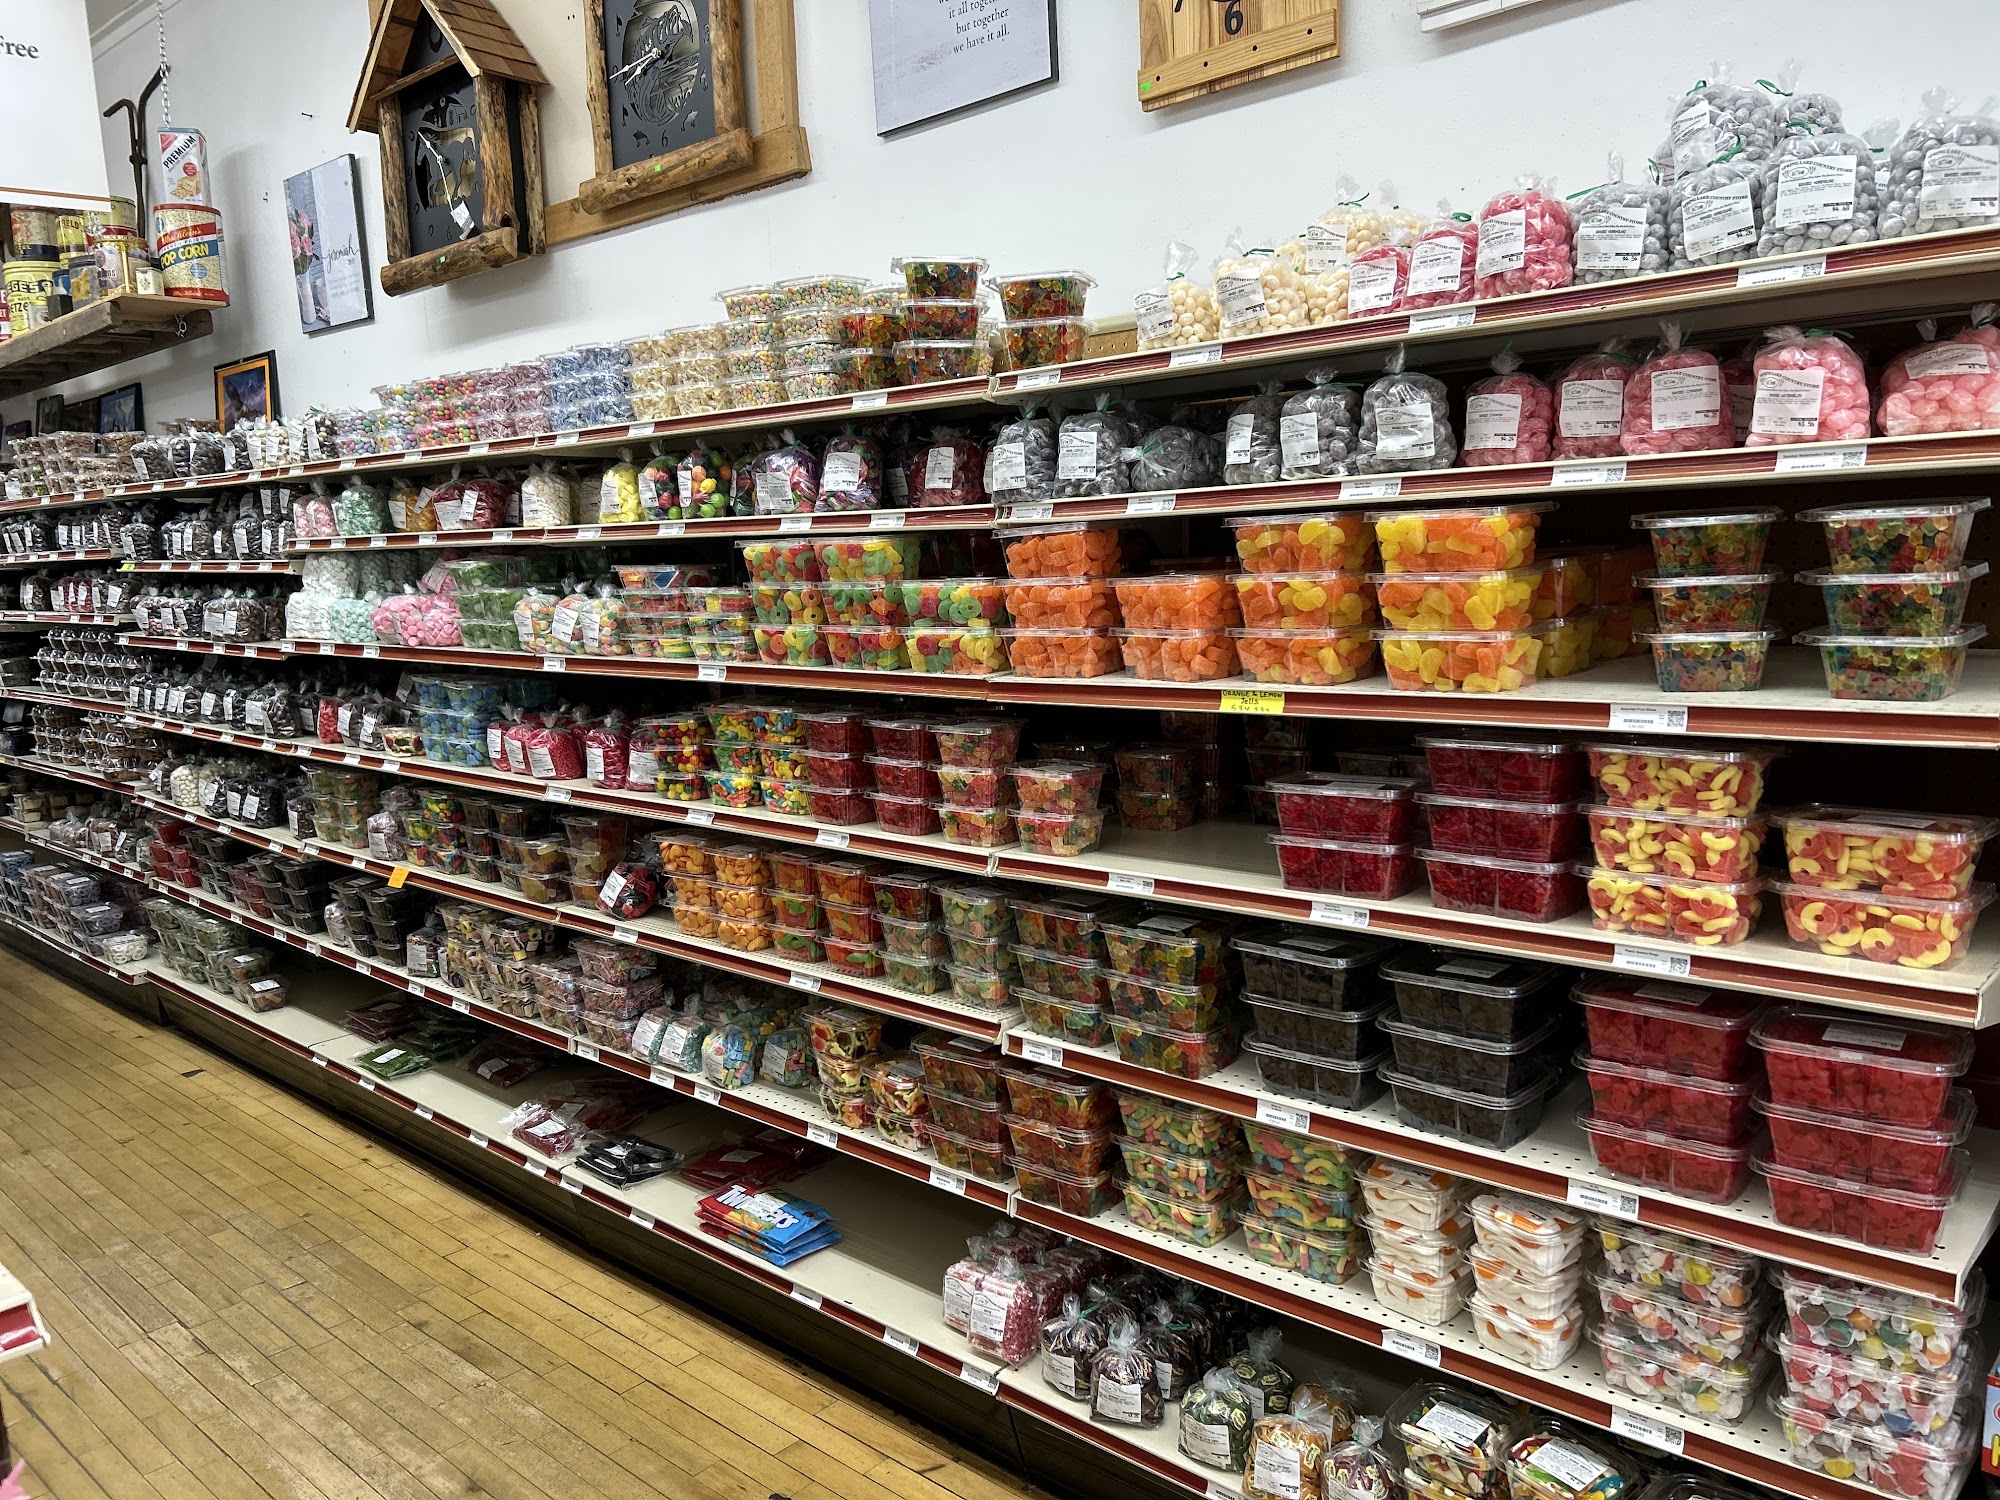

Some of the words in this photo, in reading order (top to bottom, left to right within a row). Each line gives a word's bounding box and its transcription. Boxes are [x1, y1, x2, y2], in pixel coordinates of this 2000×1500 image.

[949, 7, 956, 18] it
[958, 1, 968, 15] all
[957, 20, 970, 34] but
[974, 8, 1009, 29] together
[953, 43, 964, 54] we
[967, 36, 984, 50] have
[988, 30, 995, 41] it
[997, 24, 1010, 39] all.
[163, 135, 197, 169] PREMIUM
[1813, 162, 1837, 171] COUNTRY
[160, 251, 177, 269] POP
[178, 243, 210, 261] CORN
[1683, 373, 1703, 381] COUNTRY
[1222, 689, 1250, 697] ORANGE
[1240, 697, 1259, 705] Jells
